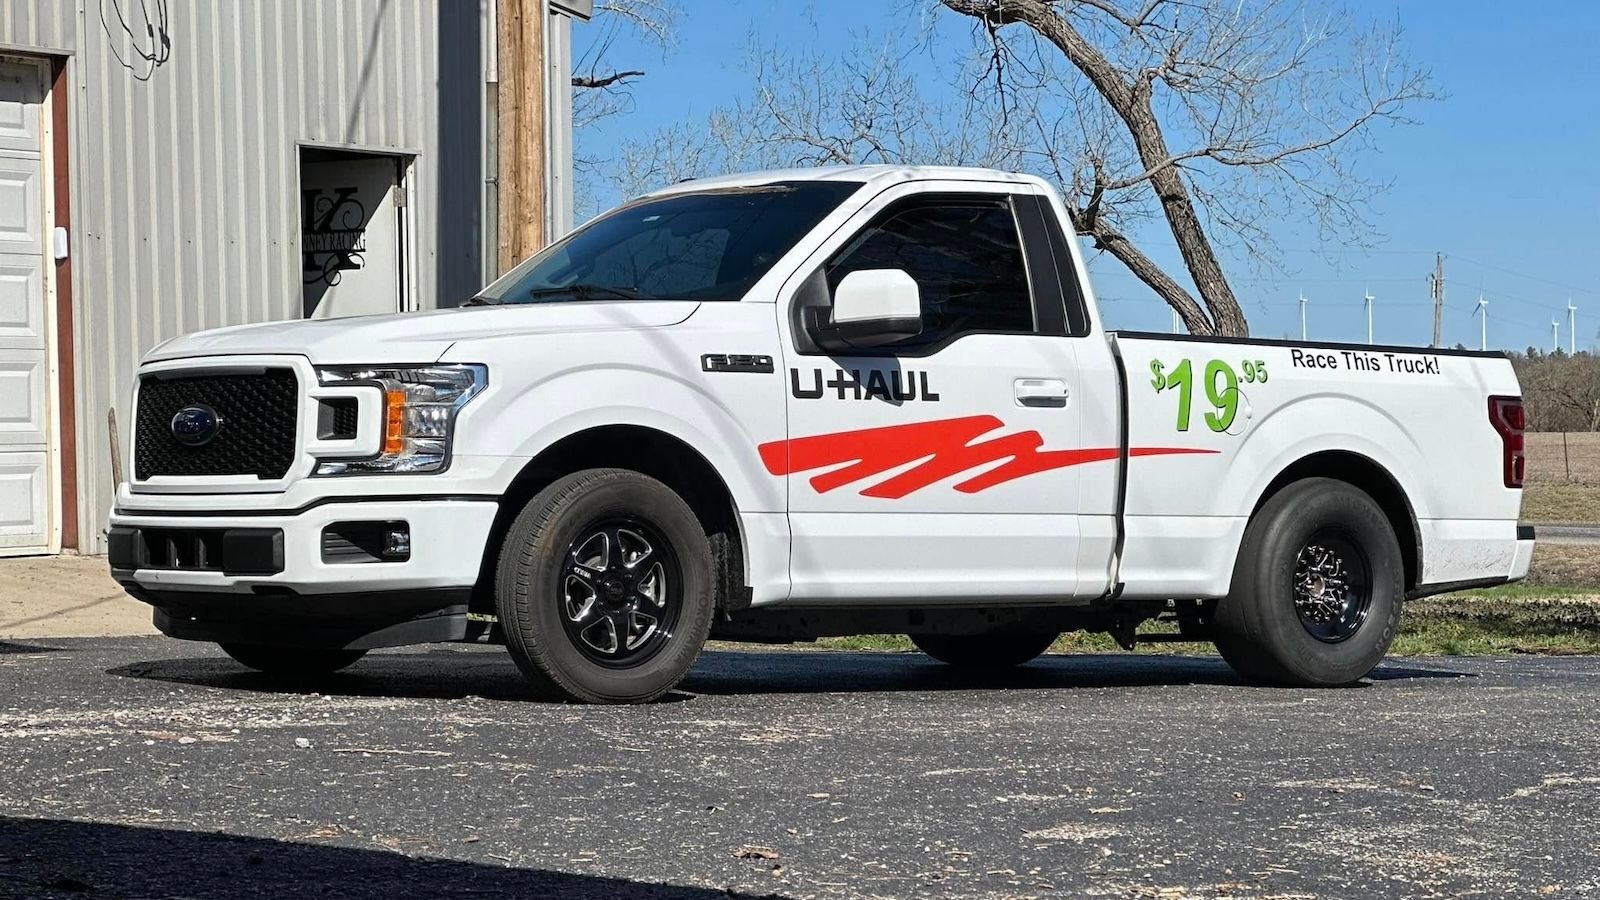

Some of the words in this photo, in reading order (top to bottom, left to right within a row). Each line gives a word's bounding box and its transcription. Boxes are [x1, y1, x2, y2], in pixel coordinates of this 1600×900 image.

[329, 231, 366, 250] RACING
[1290, 349, 1338, 369] Race
[1340, 352, 1381, 372] This
[1384, 354, 1440, 375] Truck!
[790, 368, 940, 402] U-HAUL
